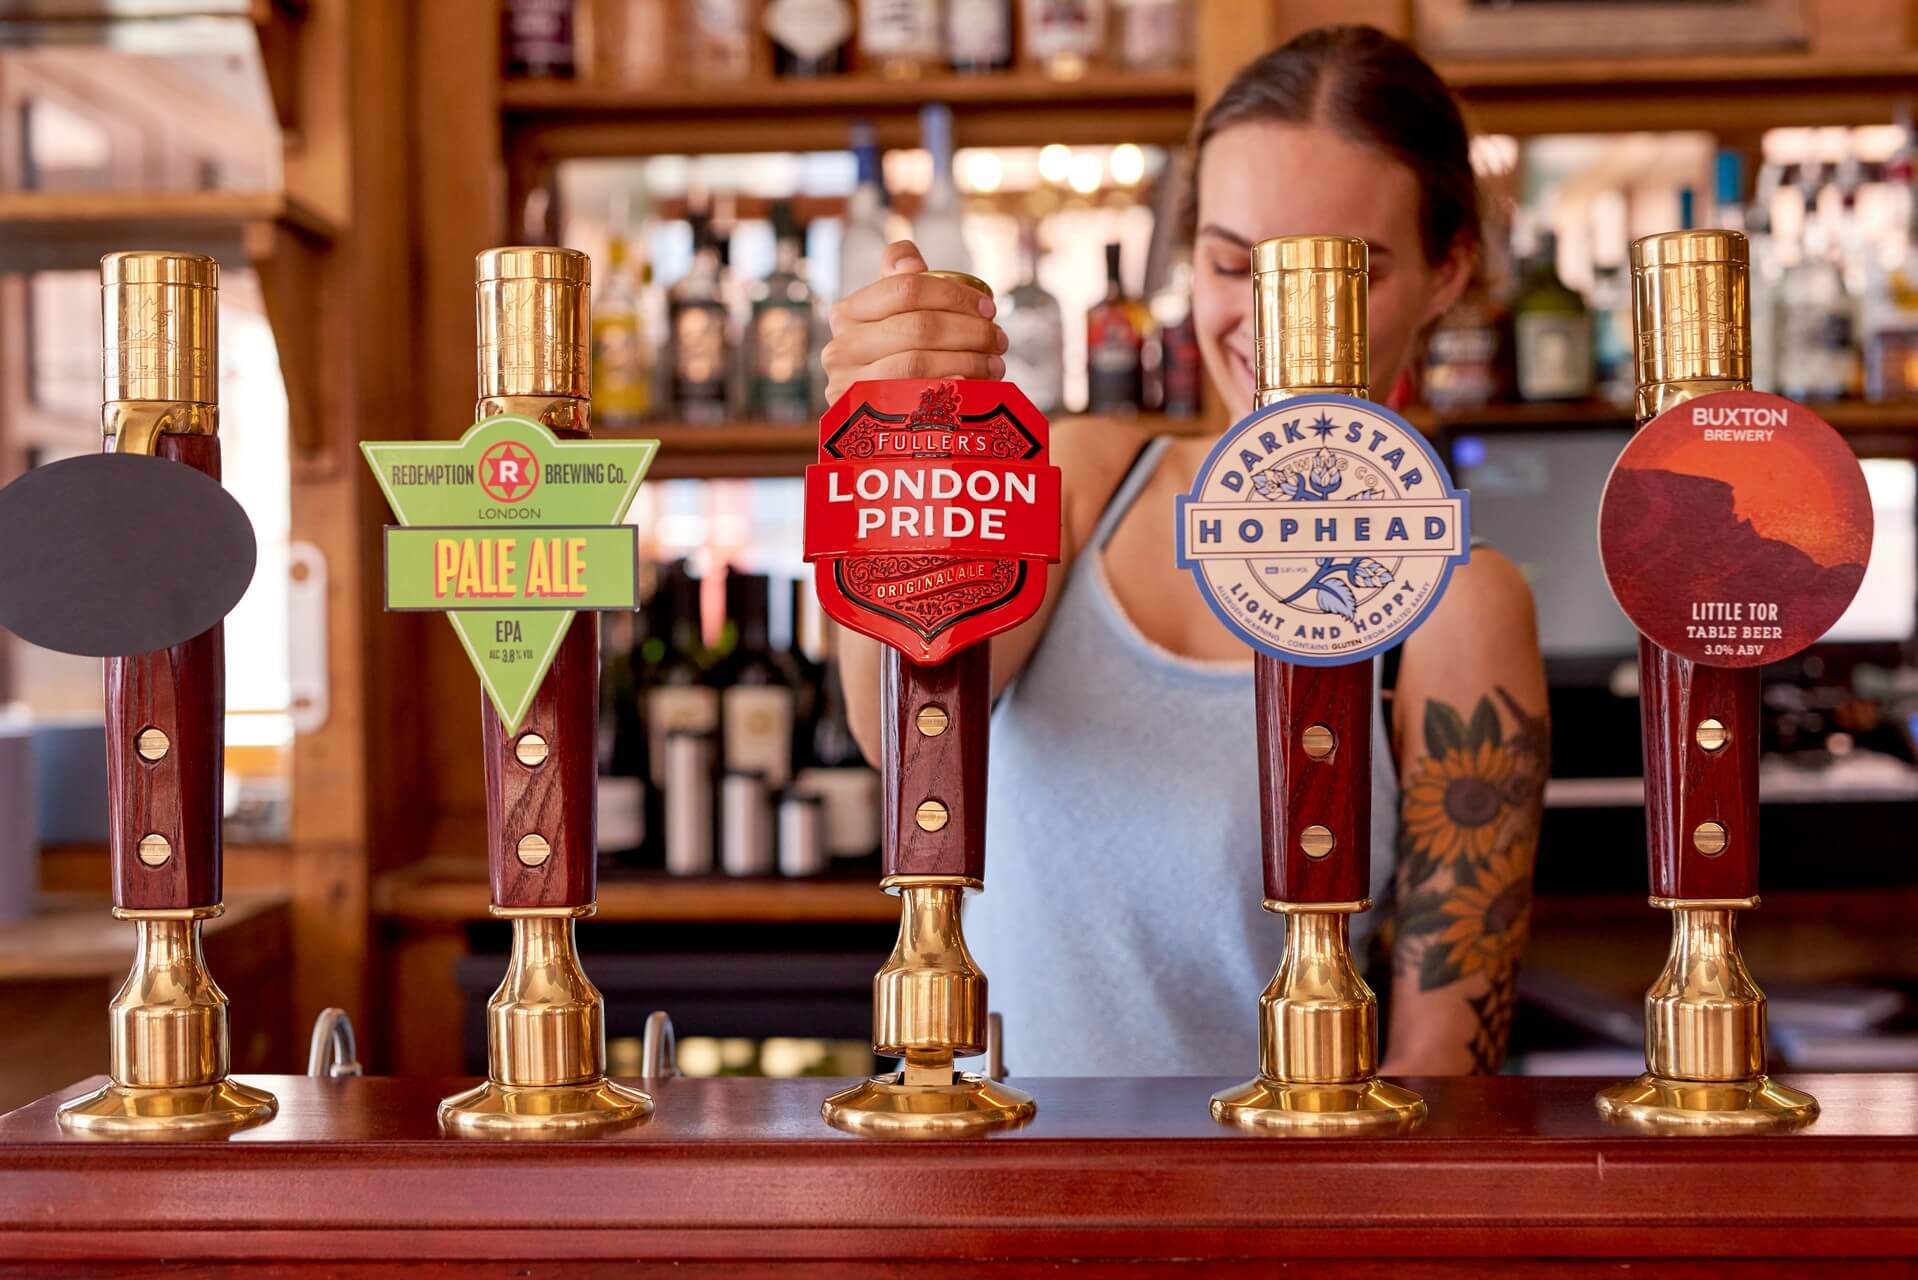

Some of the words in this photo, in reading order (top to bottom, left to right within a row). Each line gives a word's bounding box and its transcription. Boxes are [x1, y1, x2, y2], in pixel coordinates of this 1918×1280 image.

[1692, 408, 1788, 426] BUXTON
[878, 432, 986, 452] FULLER'S
[1703, 429, 1774, 441] BREWERY
[1220, 419, 1306, 493] DARK
[1345, 421, 1422, 491] STAR
[392, 464, 474, 486] REDEMPTION
[545, 463, 604, 484] BREWING
[607, 464, 627, 484] Co.
[499, 460, 519, 482] R
[828, 468, 1036, 504] LONDON
[478, 508, 541, 520] LONDON
[857, 505, 1006, 540] PRIDE
[1199, 516, 1447, 543] HOPHEAD
[434, 538, 516, 598] PALE
[525, 538, 587, 597] ALE
[876, 571, 953, 598] ORIGINAL
[956, 564, 985, 580] ALE
[1230, 583, 1285, 630] LIGHT
[1294, 624, 1341, 640] AND
[1353, 579, 1415, 634] HOPPY
[1692, 603, 1743, 621] LITTLE
[1749, 603, 1778, 621] TOR
[496, 620, 522, 643] EPA
[1687, 626, 1737, 639] TABLE
[1743, 626, 1782, 639] BEER
[1331, 639, 1362, 650] GLUTEN
[1704, 645, 1734, 655] 3.0%
[1737, 645, 1764, 655] ABV
